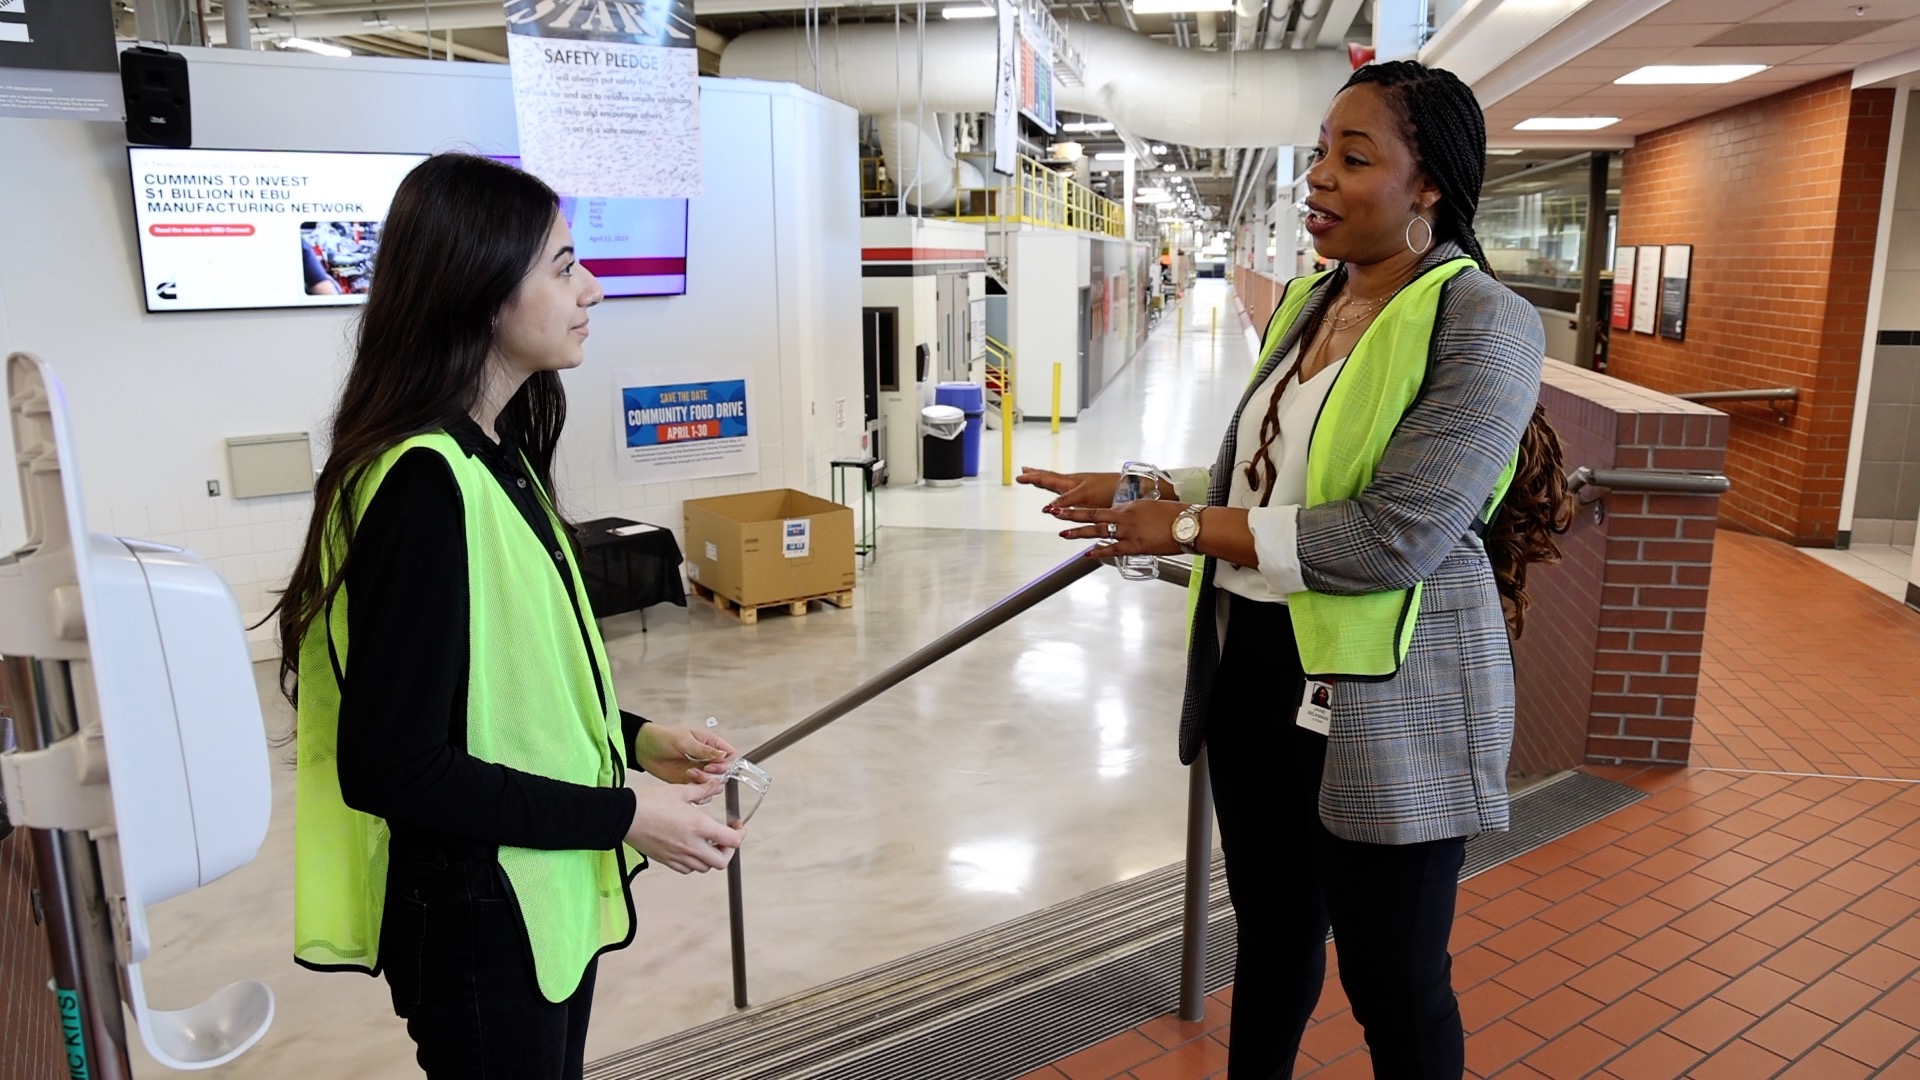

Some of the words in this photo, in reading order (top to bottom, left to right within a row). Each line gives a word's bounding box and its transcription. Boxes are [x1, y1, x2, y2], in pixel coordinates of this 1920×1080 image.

[544, 48, 599, 66] SAFETY
[605, 52, 659, 70] PLEDGE
[555, 73, 569, 81] will
[571, 74, 599, 85] always
[601, 76, 614, 86] put
[616, 77, 636, 87] safety
[563, 91, 579, 99] and
[580, 92, 592, 100] act
[594, 92, 602, 100] to
[604, 93, 630, 101] resolve
[583, 108, 598, 117] and
[600, 111, 638, 120] encourage
[572, 125, 583, 133] act
[144, 174, 223, 186] CUMMINS
[229, 175, 249, 186] TO
[256, 176, 308, 187] INVEST
[171, 188, 233, 200] BILLION
[240, 190, 254, 199] IN
[260, 190, 290, 200] EBU
[148, 202, 285, 213] MANUFACTURING
[291, 203, 364, 213] NETWORK
[660, 392, 677, 404] SAVE
[678, 391, 690, 402] THE
[691, 390, 707, 401] DATE
[628, 406, 688, 426] COMMUNITY
[690, 404, 714, 420] FOOD
[716, 401, 744, 418] DRIVE
[667, 425, 690, 440] APRIL
[691, 424, 708, 437] 1-30
[58, 995, 80, 1046] KITS
